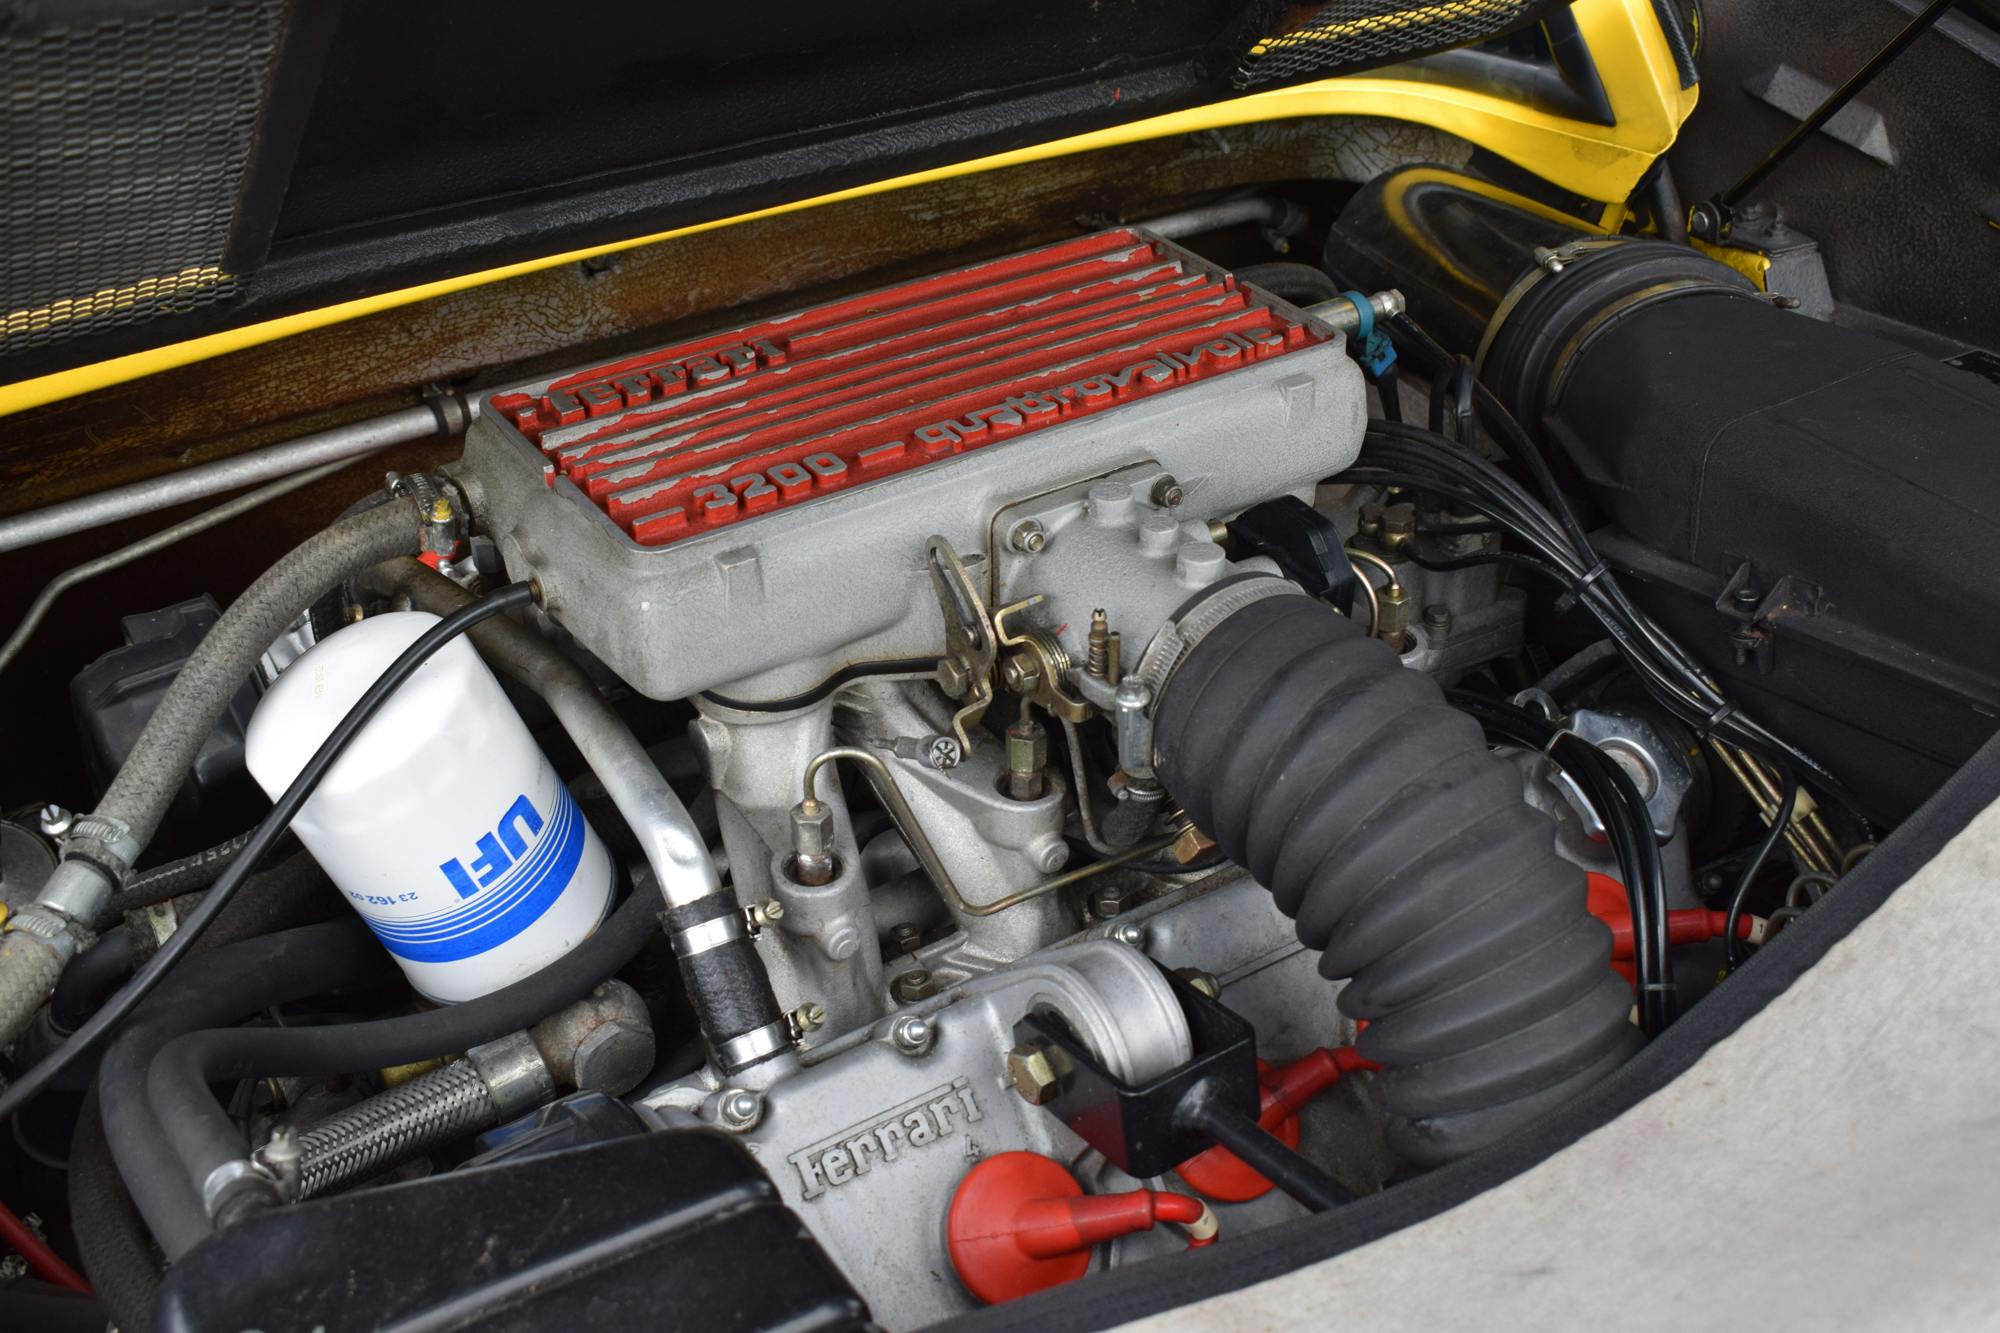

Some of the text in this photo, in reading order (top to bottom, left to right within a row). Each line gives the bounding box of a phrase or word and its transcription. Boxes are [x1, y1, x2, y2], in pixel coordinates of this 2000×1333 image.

[545, 337, 786, 423] Ferrari
[693, 327, 1284, 520] 3200 quattrovalvole
[439, 793, 545, 900] UFI
[365, 895, 397, 906] 162
[398, 892, 418, 902] 23
[788, 1075, 982, 1201] Ferrari
